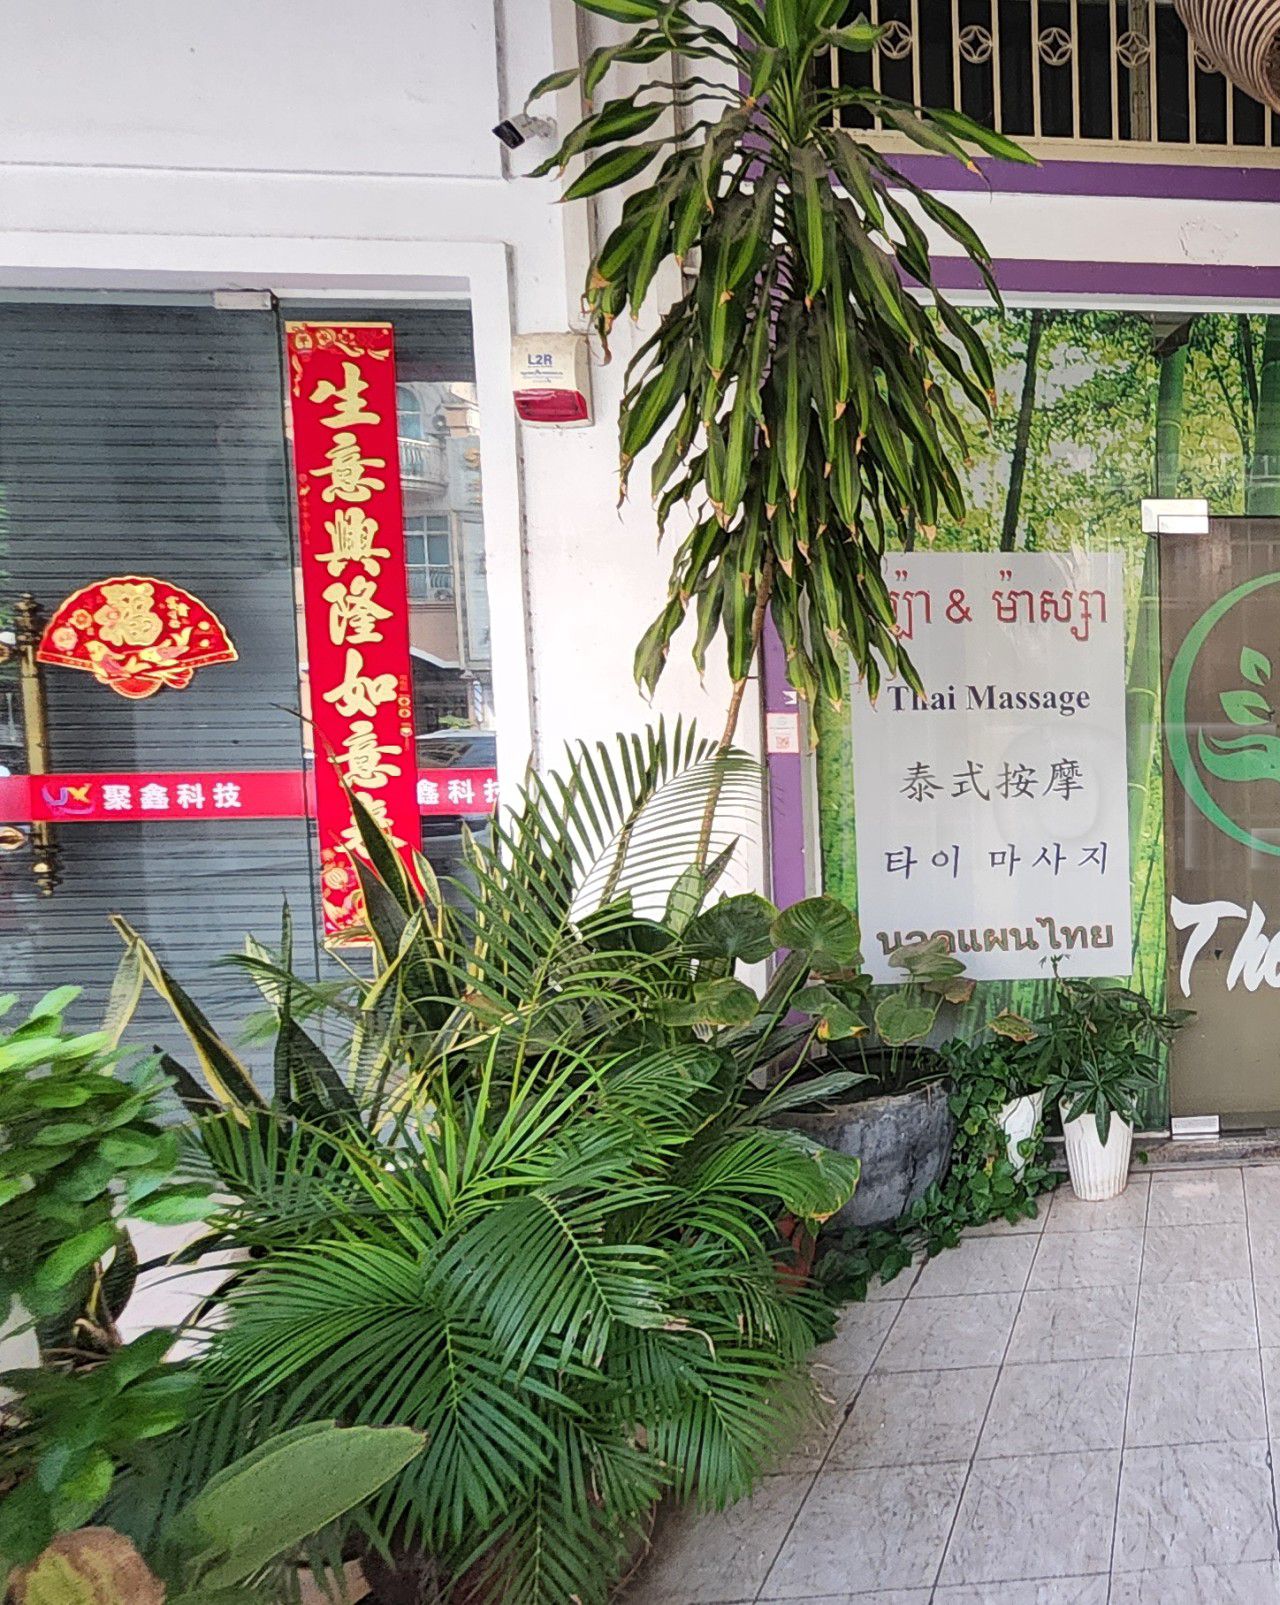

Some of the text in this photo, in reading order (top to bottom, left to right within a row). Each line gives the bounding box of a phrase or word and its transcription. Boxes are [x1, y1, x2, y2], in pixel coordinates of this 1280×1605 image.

[526, 353, 554, 366] L2R
[945, 588, 974, 625] &
[886, 684, 1091, 717] Thai Massage
[101, 782, 243, 811] 聚鑫科技
[899, 757, 1085, 803] 泰式按摩
[884, 841, 1109, 880] 타이 마사지
